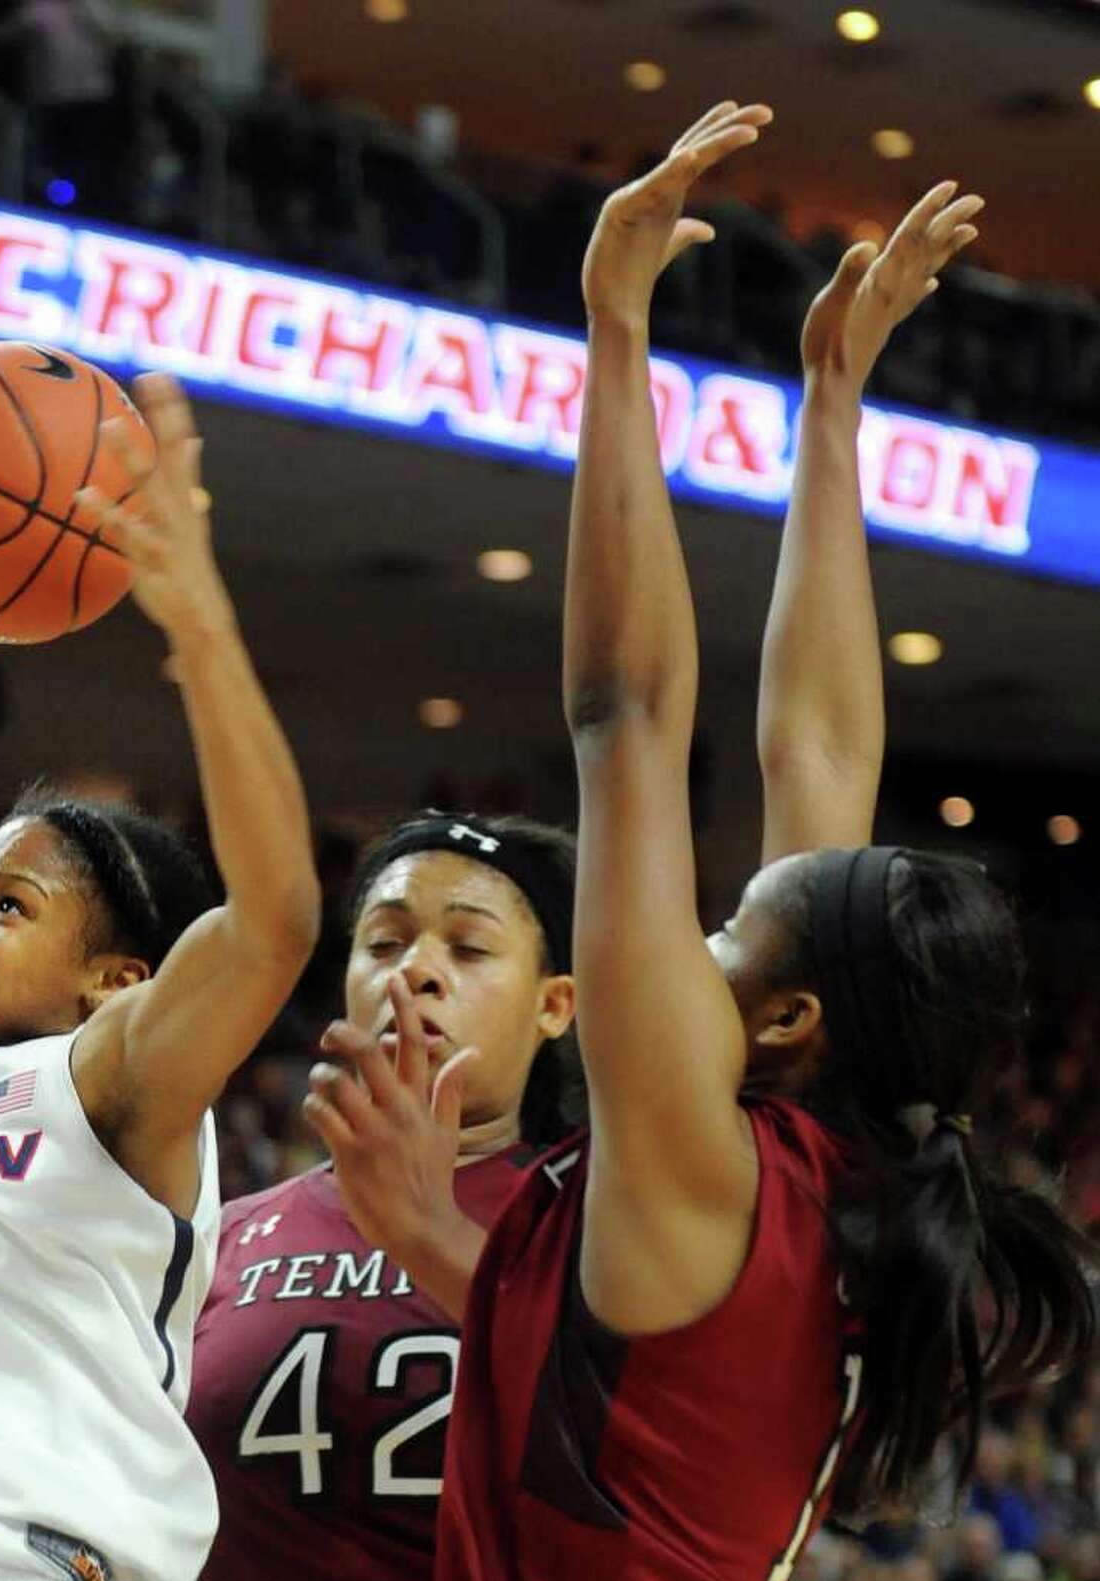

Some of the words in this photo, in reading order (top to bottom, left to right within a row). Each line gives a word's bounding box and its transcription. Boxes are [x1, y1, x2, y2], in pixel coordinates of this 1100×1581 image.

[686, 373, 800, 502] &
[857, 404, 1041, 556] ON
[238, 1331, 462, 1496] 42
